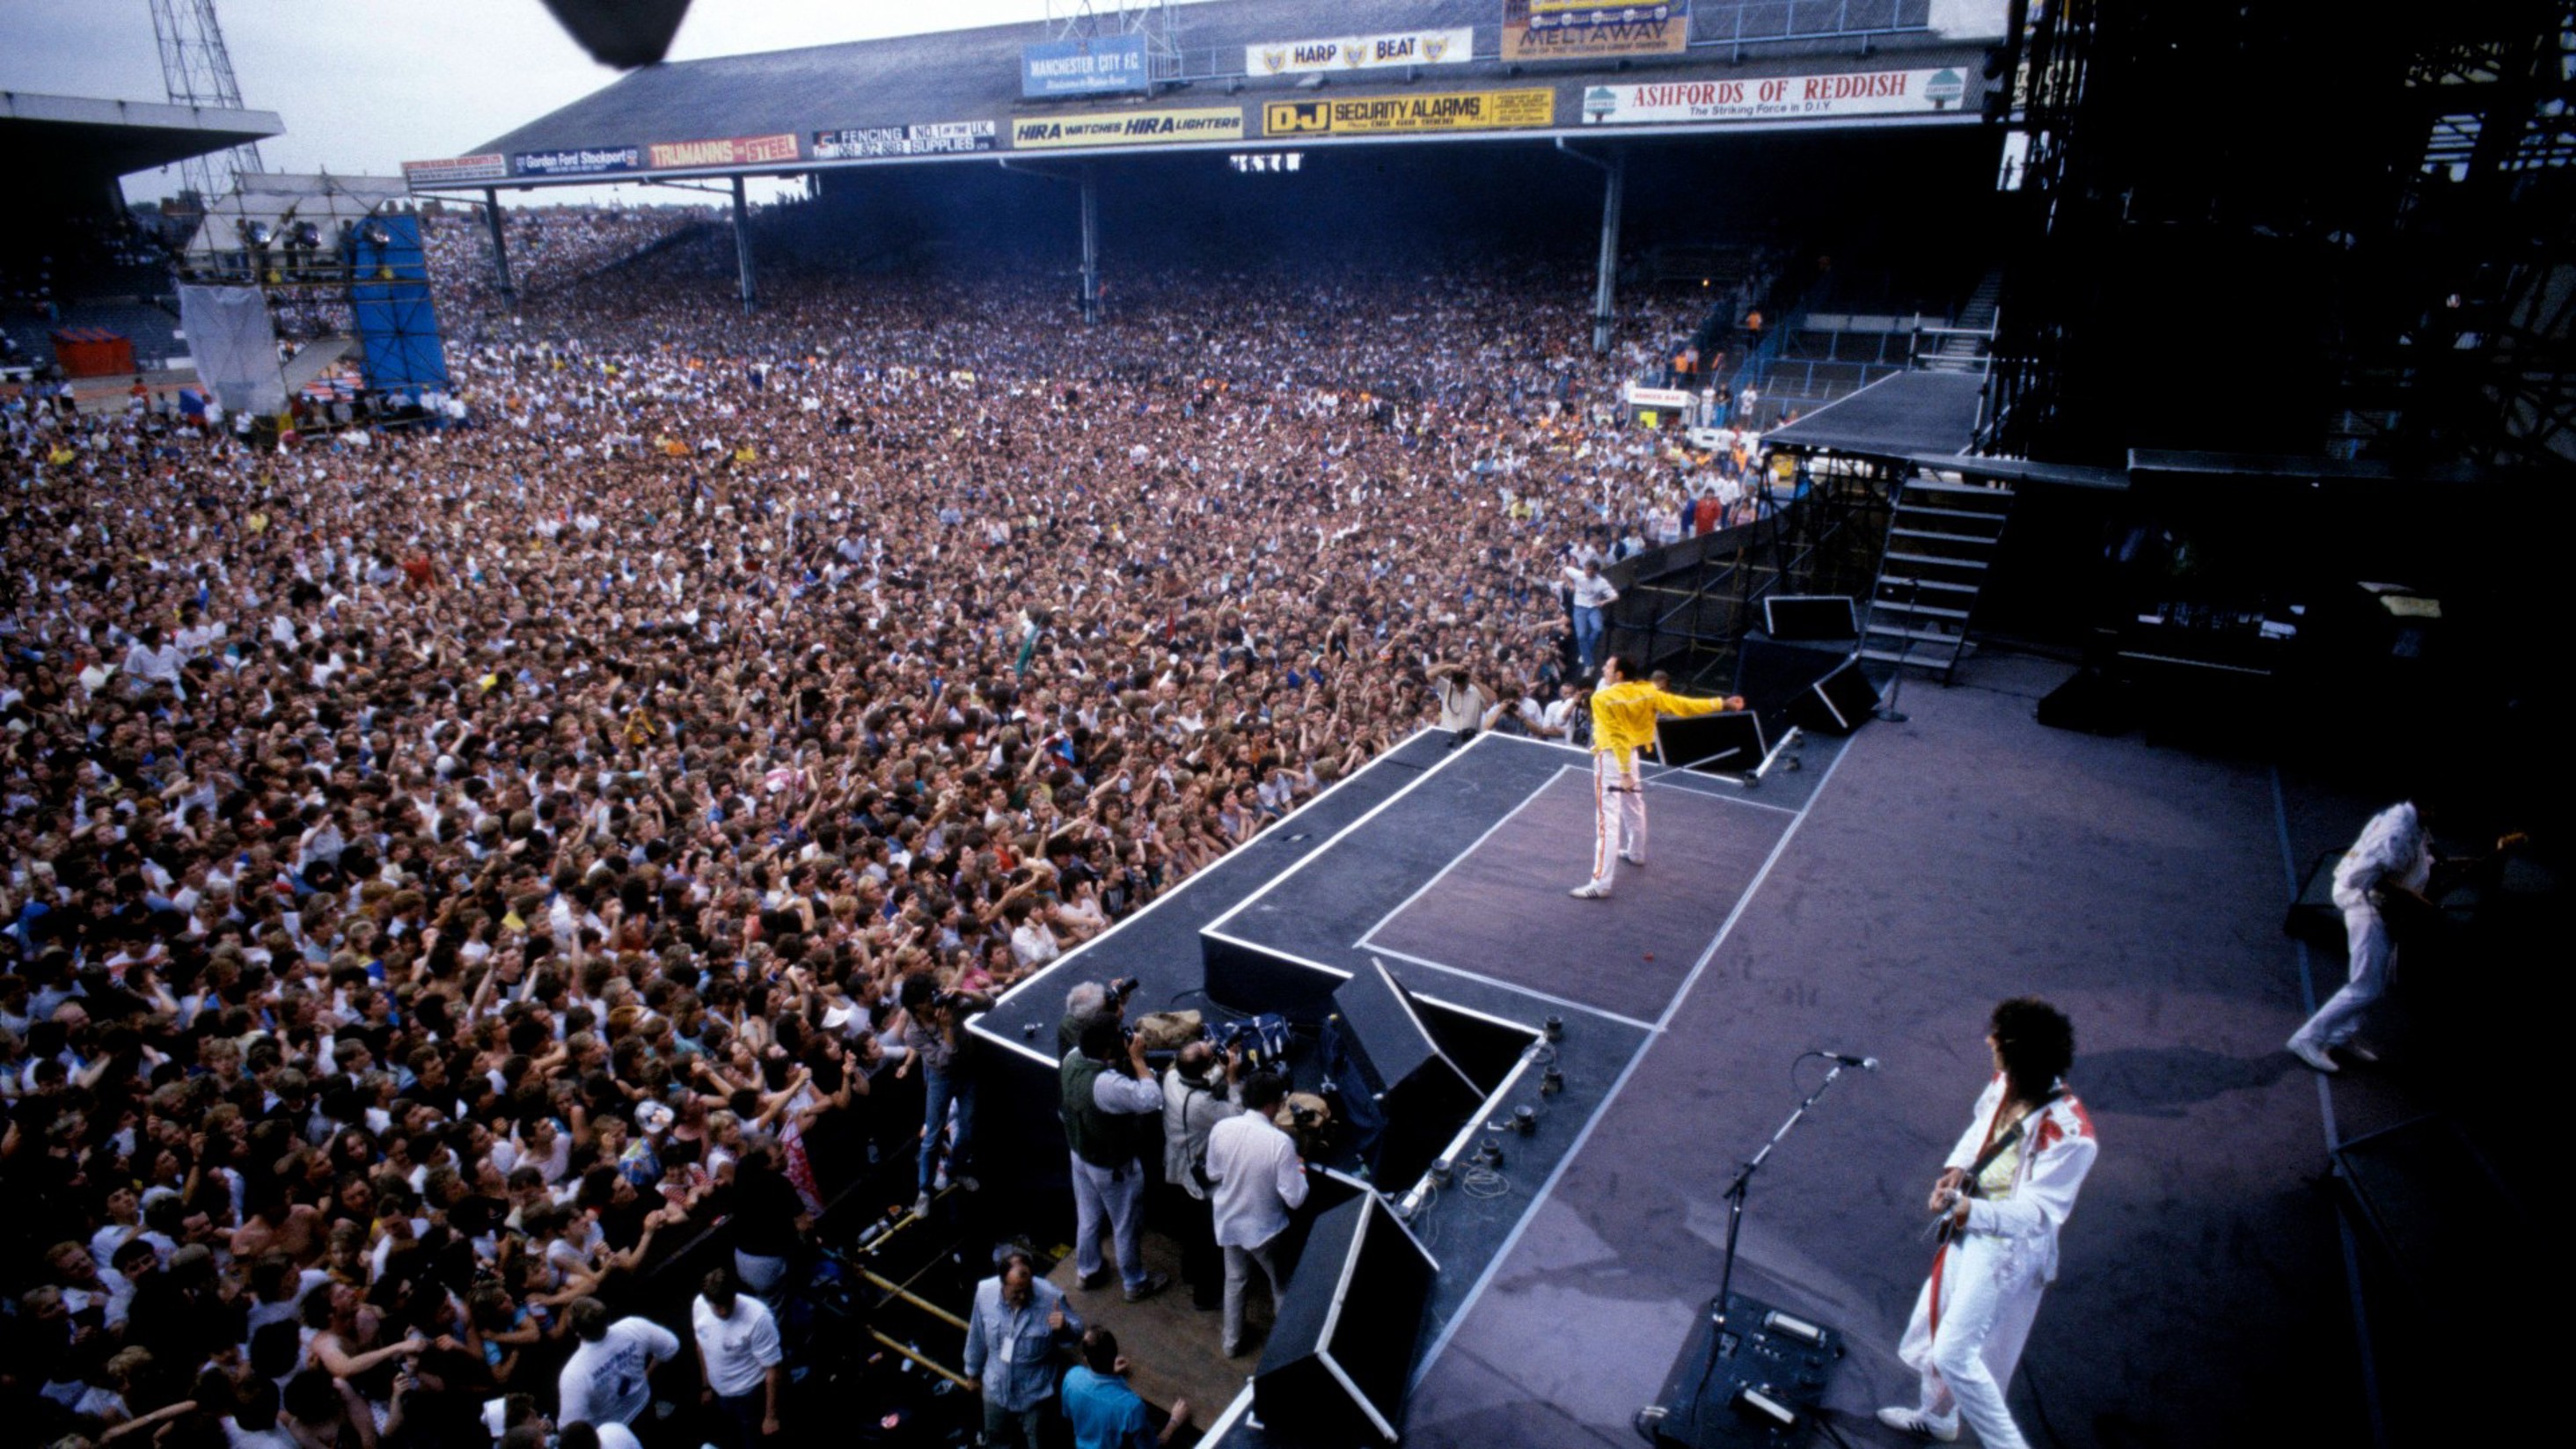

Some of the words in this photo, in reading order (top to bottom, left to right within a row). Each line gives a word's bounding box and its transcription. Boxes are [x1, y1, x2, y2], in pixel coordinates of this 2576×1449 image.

[1519, 22, 1666, 47] MELTAWAY
[1294, 45, 1336, 63] HARP
[1377, 38, 1416, 59] BEAT
[1030, 55, 1094, 77] MANCHESTER
[1099, 54, 1120, 72] CITY
[1632, 81, 1745, 107] ASHFORDS
[1759, 79, 1789, 102] OF
[1804, 73, 1907, 99] REDDISH
[1335, 100, 1408, 121] SECURITY
[1410, 96, 1481, 119] ALARMS
[1689, 106, 1708, 115] The
[1712, 103, 1753, 115] Striking
[1757, 104, 1787, 114] Force
[1790, 103, 1799, 112] in
[841, 128, 903, 143] FENCING
[1017, 123, 1061, 141] HIRA
[1065, 122, 1122, 135] WATCHES
[1124, 116, 1175, 135] HIRA
[1175, 116, 1240, 131] LIGHTERS
[651, 141, 733, 167] TRUMANNS
[748, 135, 796, 162] STEEL
[912, 137, 975, 153] SUPPLIES
[526, 155, 557, 168] Gordon
[558, 152, 578, 166] Ford
[581, 149, 626, 165] Stockport
